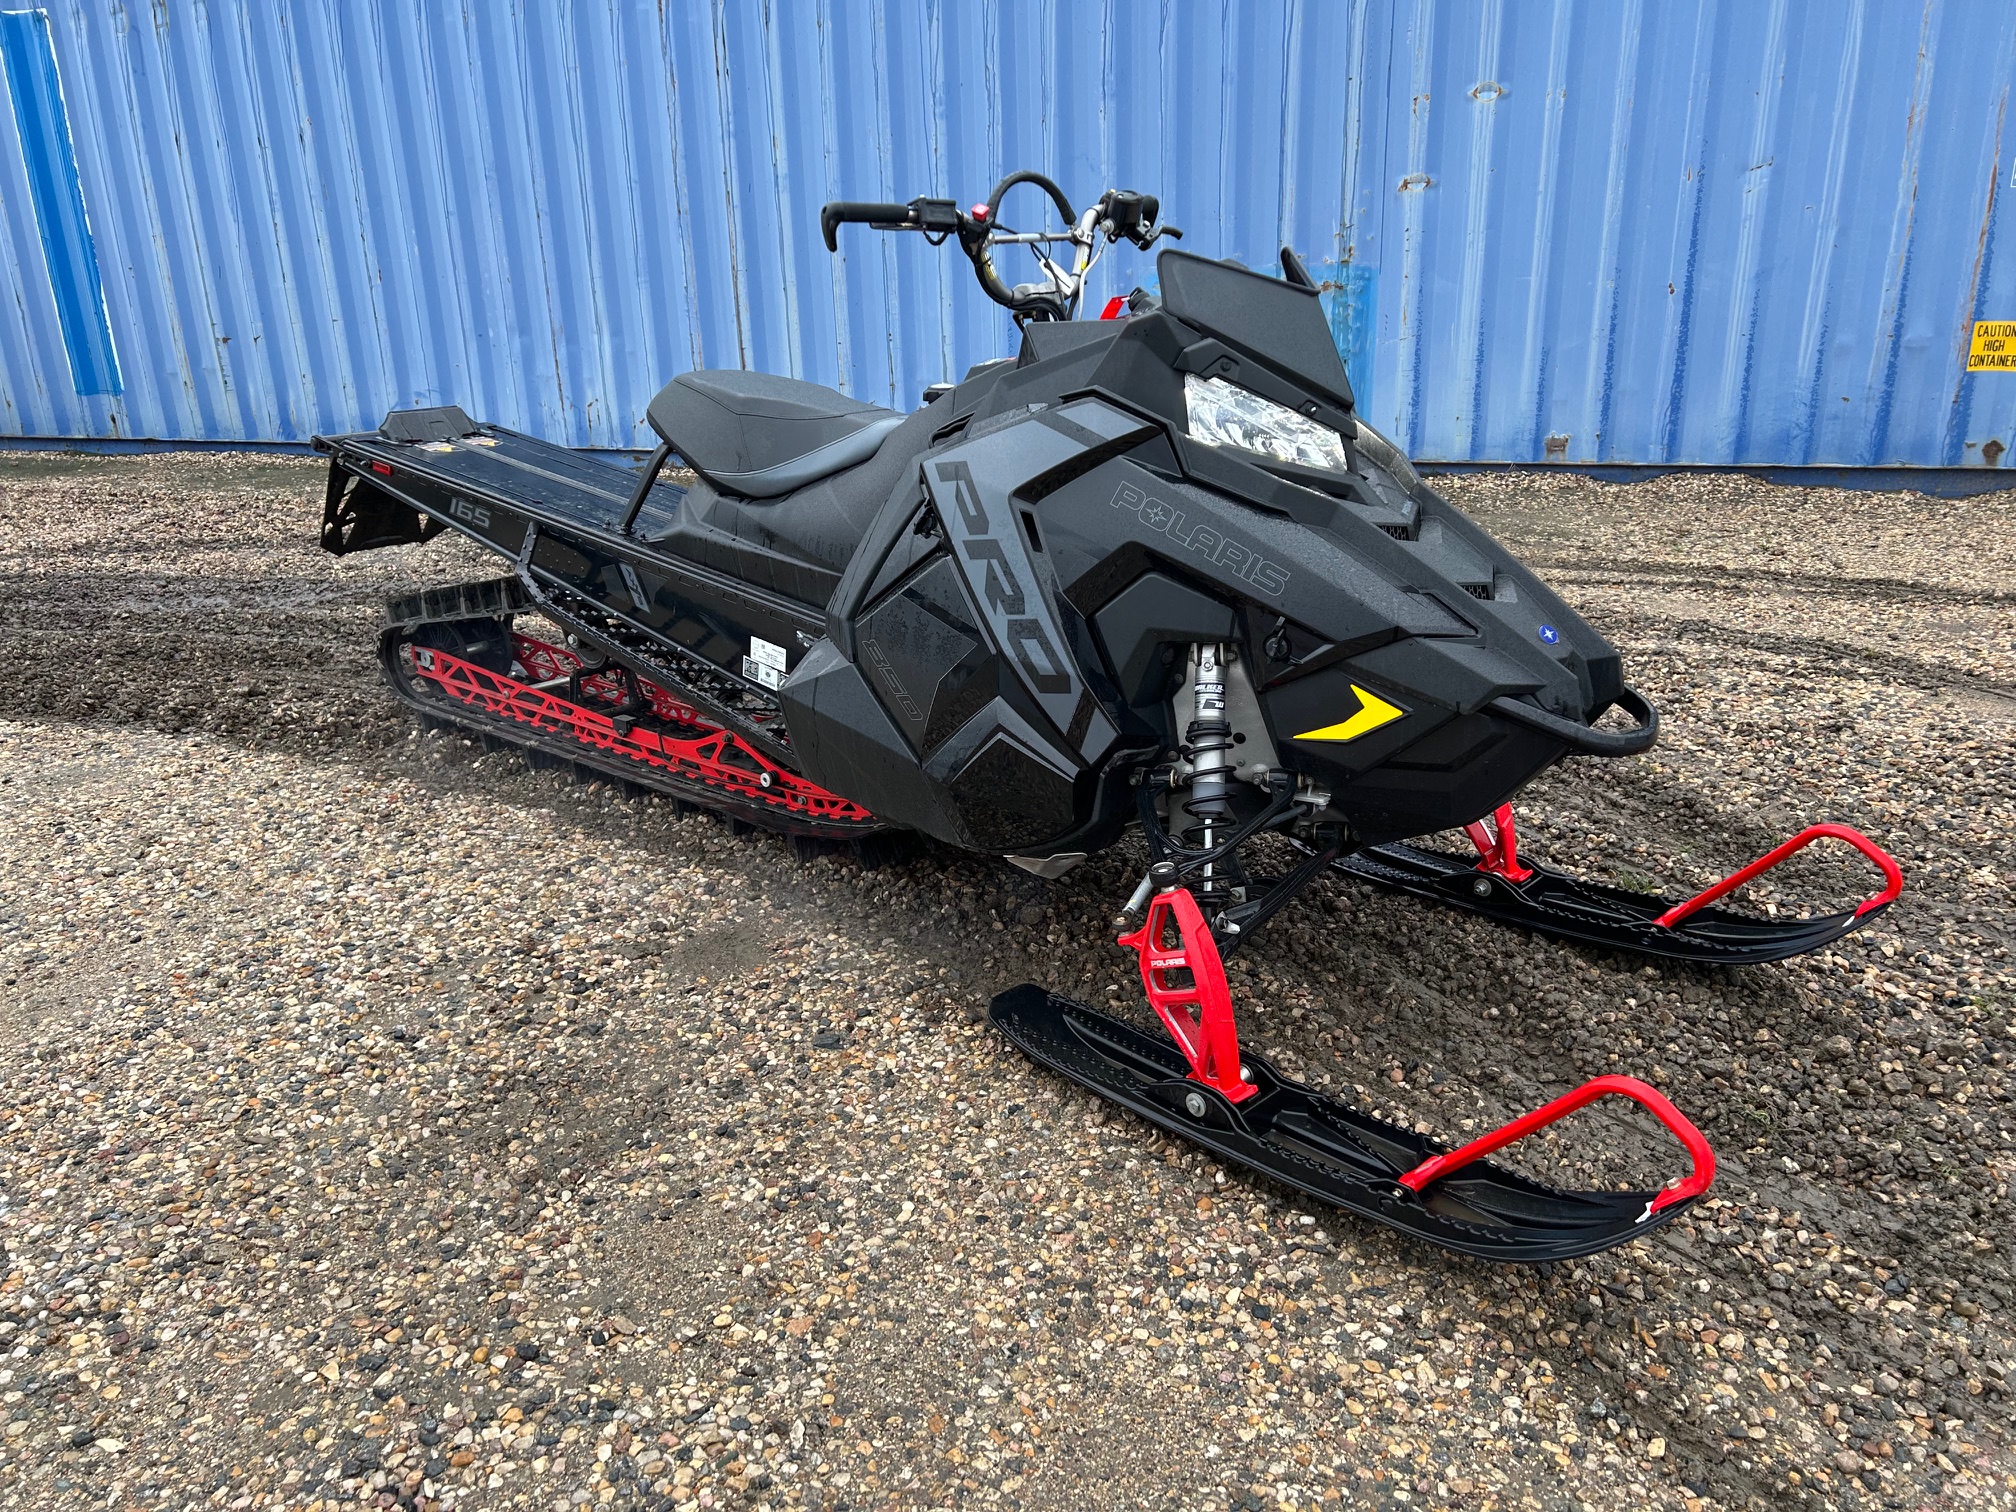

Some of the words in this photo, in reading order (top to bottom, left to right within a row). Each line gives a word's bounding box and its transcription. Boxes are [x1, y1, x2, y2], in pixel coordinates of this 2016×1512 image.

[1978, 325, 2016, 337] CAUTION
[1983, 340, 2005, 351] HIGH
[1969, 355, 2016, 367] CONTAINER
[450, 498, 490, 528] 165
[1110, 480, 1291, 597] POLARIS
[935, 461, 1071, 694] PRO
[862, 639, 923, 721] 850
[1151, 958, 1186, 967] POLARIS
